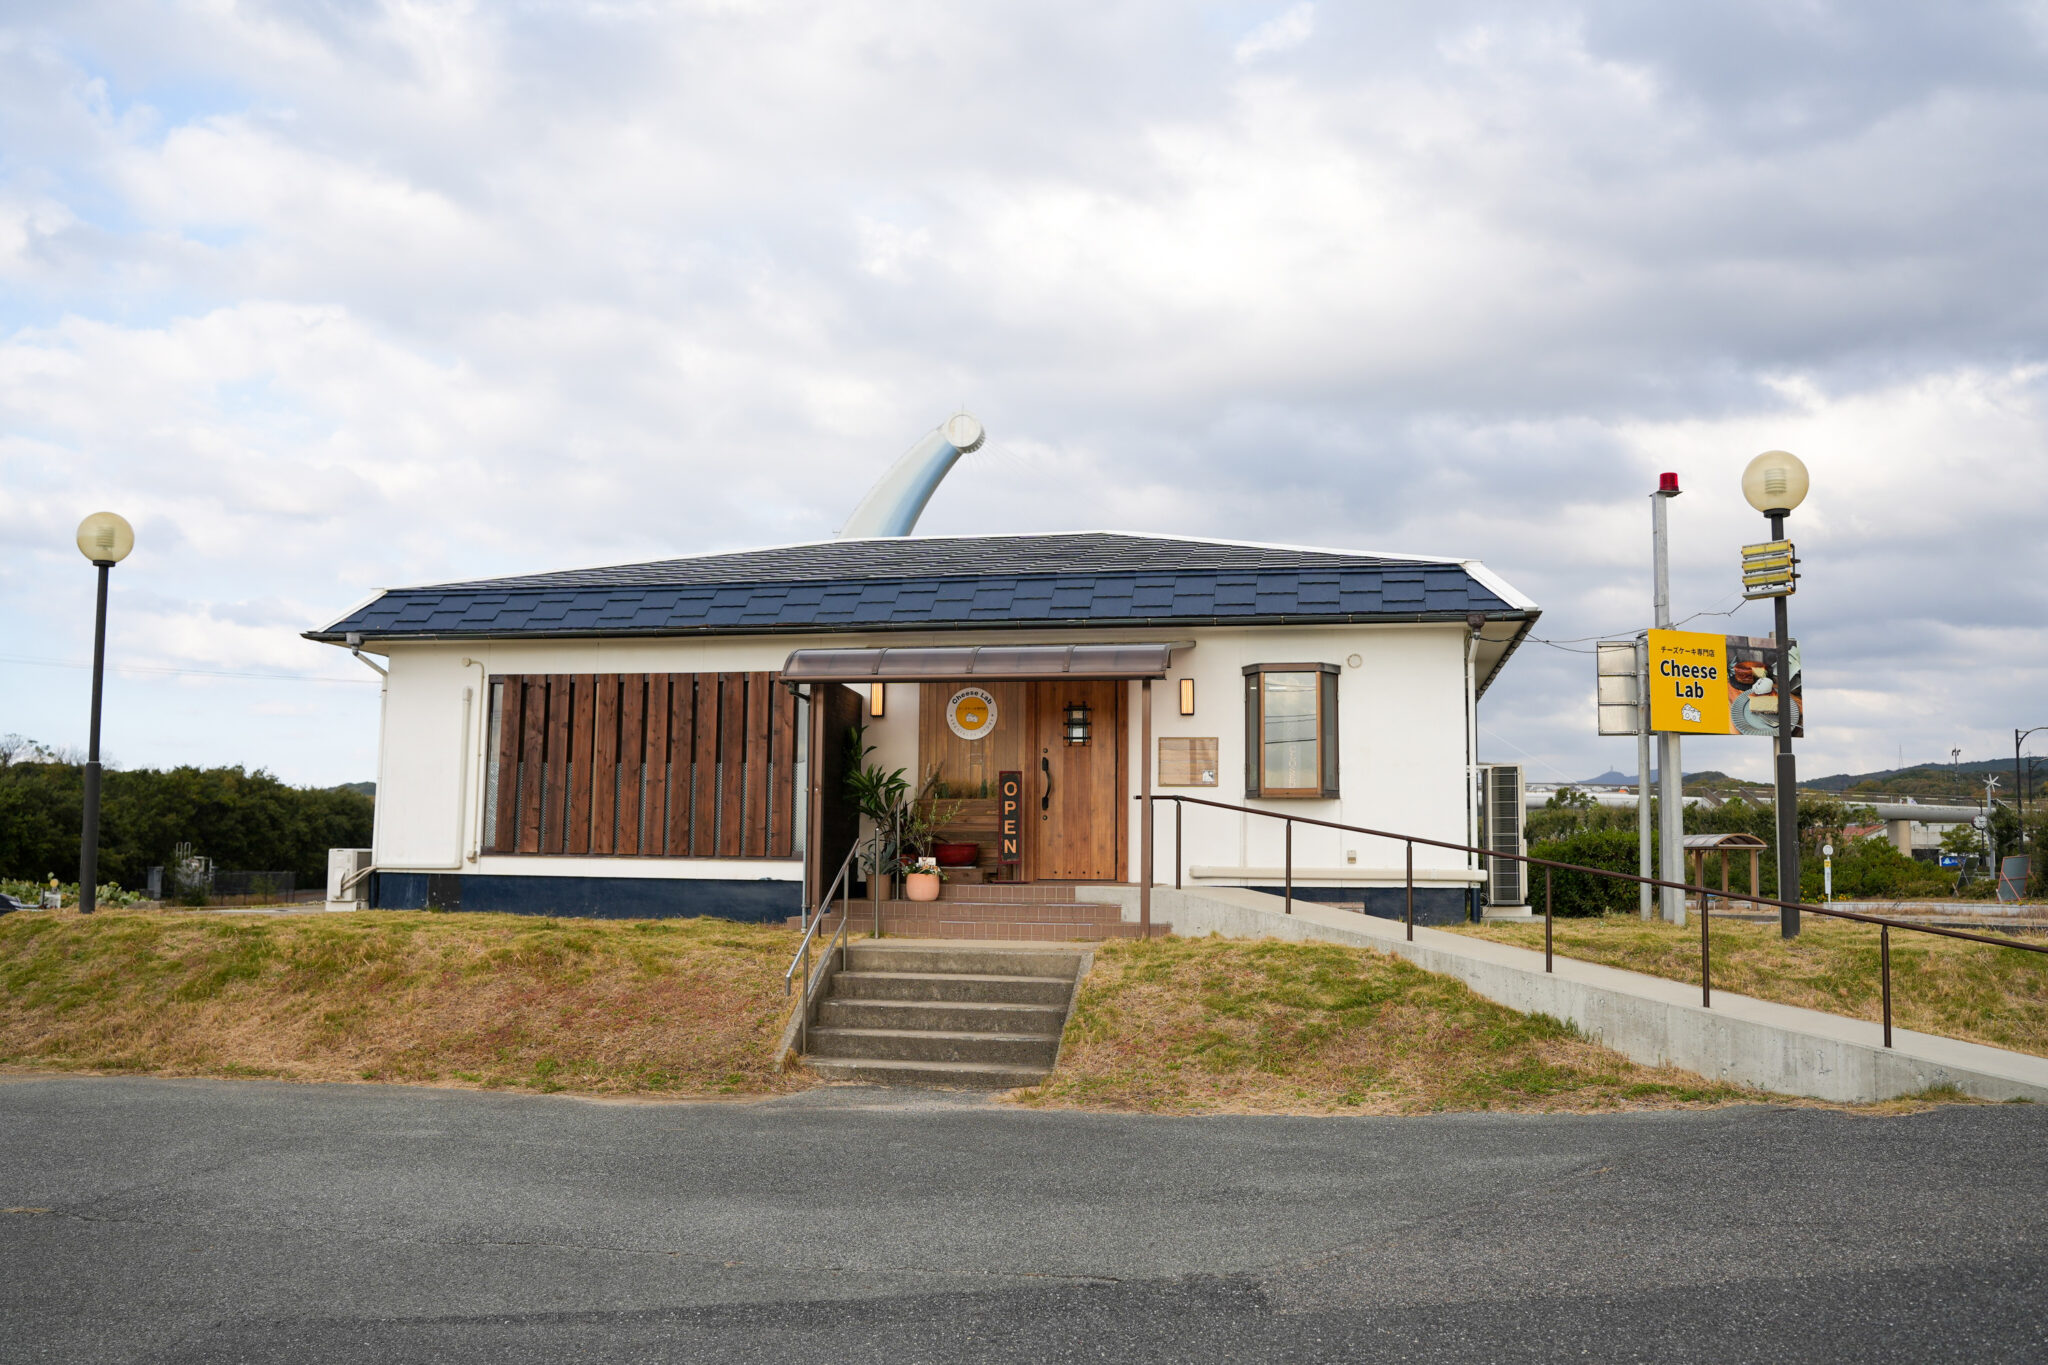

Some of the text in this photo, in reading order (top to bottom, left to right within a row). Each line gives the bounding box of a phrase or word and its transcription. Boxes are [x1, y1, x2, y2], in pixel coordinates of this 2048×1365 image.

[1660, 646, 1715, 658] チーズケーキ専門店
[1660, 660, 1717, 680] Cheese
[952, 691, 993, 704] Cheese Lab
[1675, 681, 1704, 699] Lab
[1003, 781, 1018, 854] OPEN
